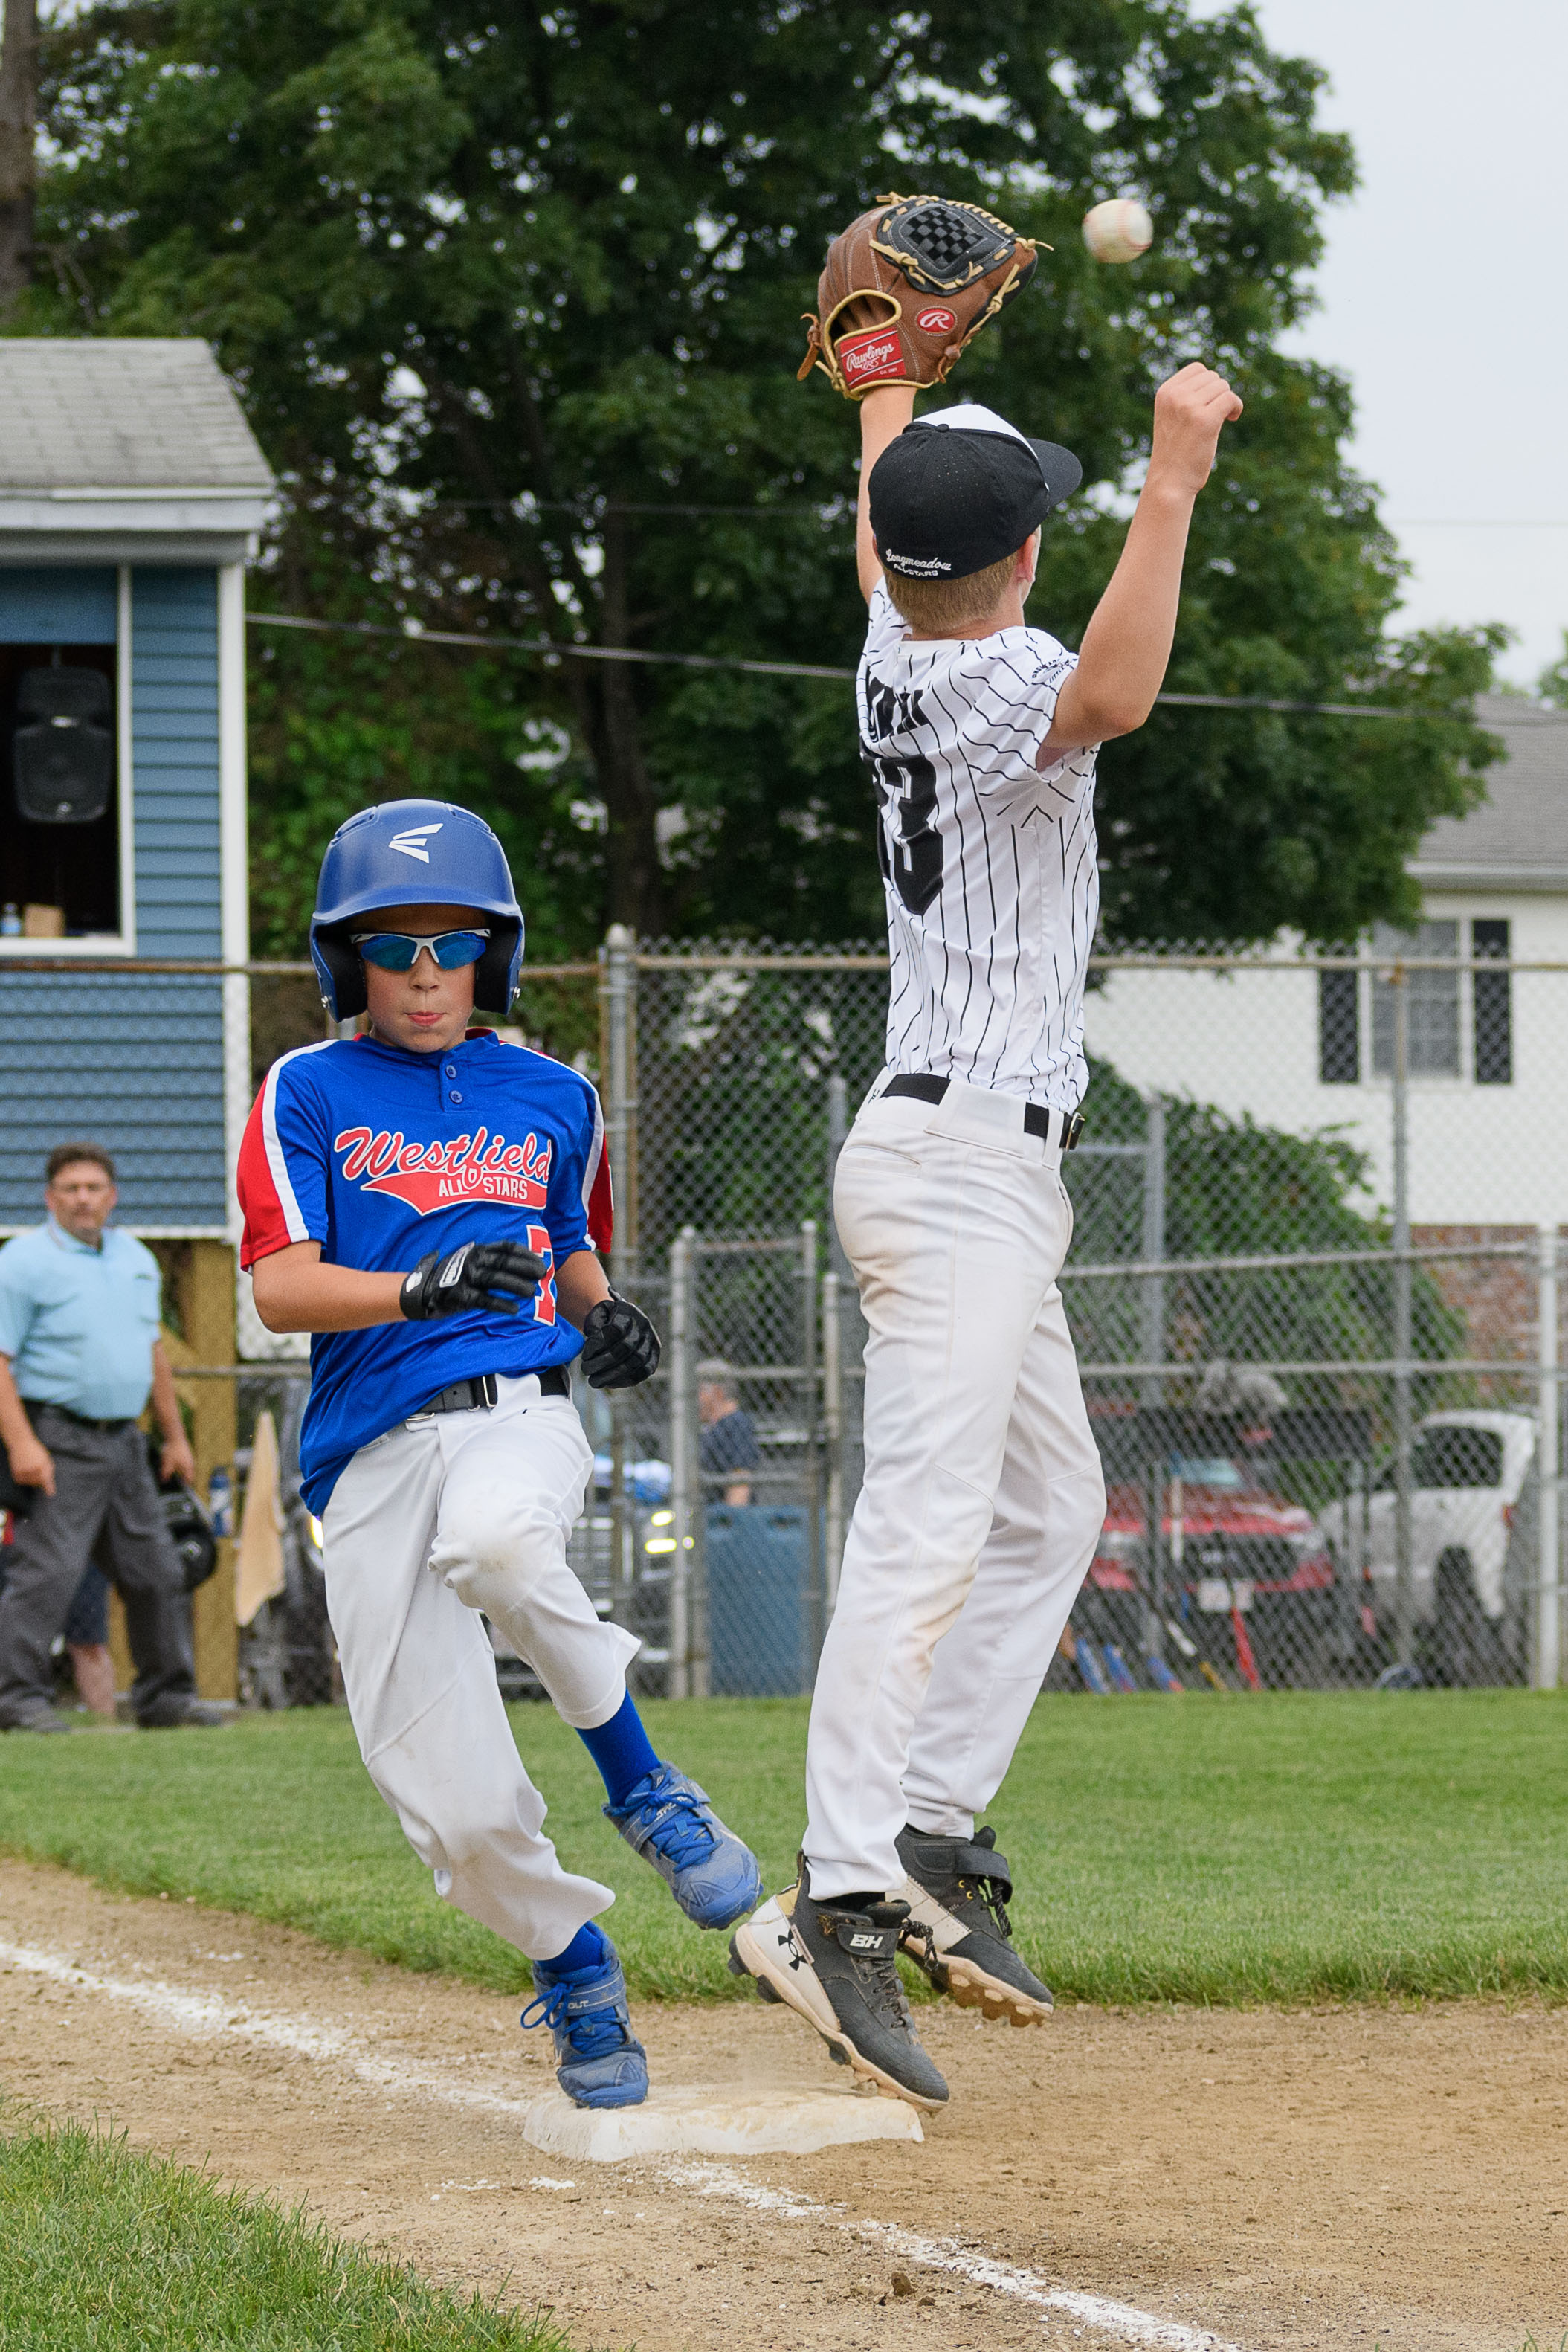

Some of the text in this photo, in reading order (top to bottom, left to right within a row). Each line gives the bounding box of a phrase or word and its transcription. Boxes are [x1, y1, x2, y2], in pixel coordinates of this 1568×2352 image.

[920, 312, 949, 329] R
[846, 343, 895, 372] Rawlings
[885, 548, 952, 570] Longmeadow
[335, 1126, 553, 1189] Westfield
[439, 1176, 529, 1200] ALL STARS
[849, 1933, 884, 1949] BH
